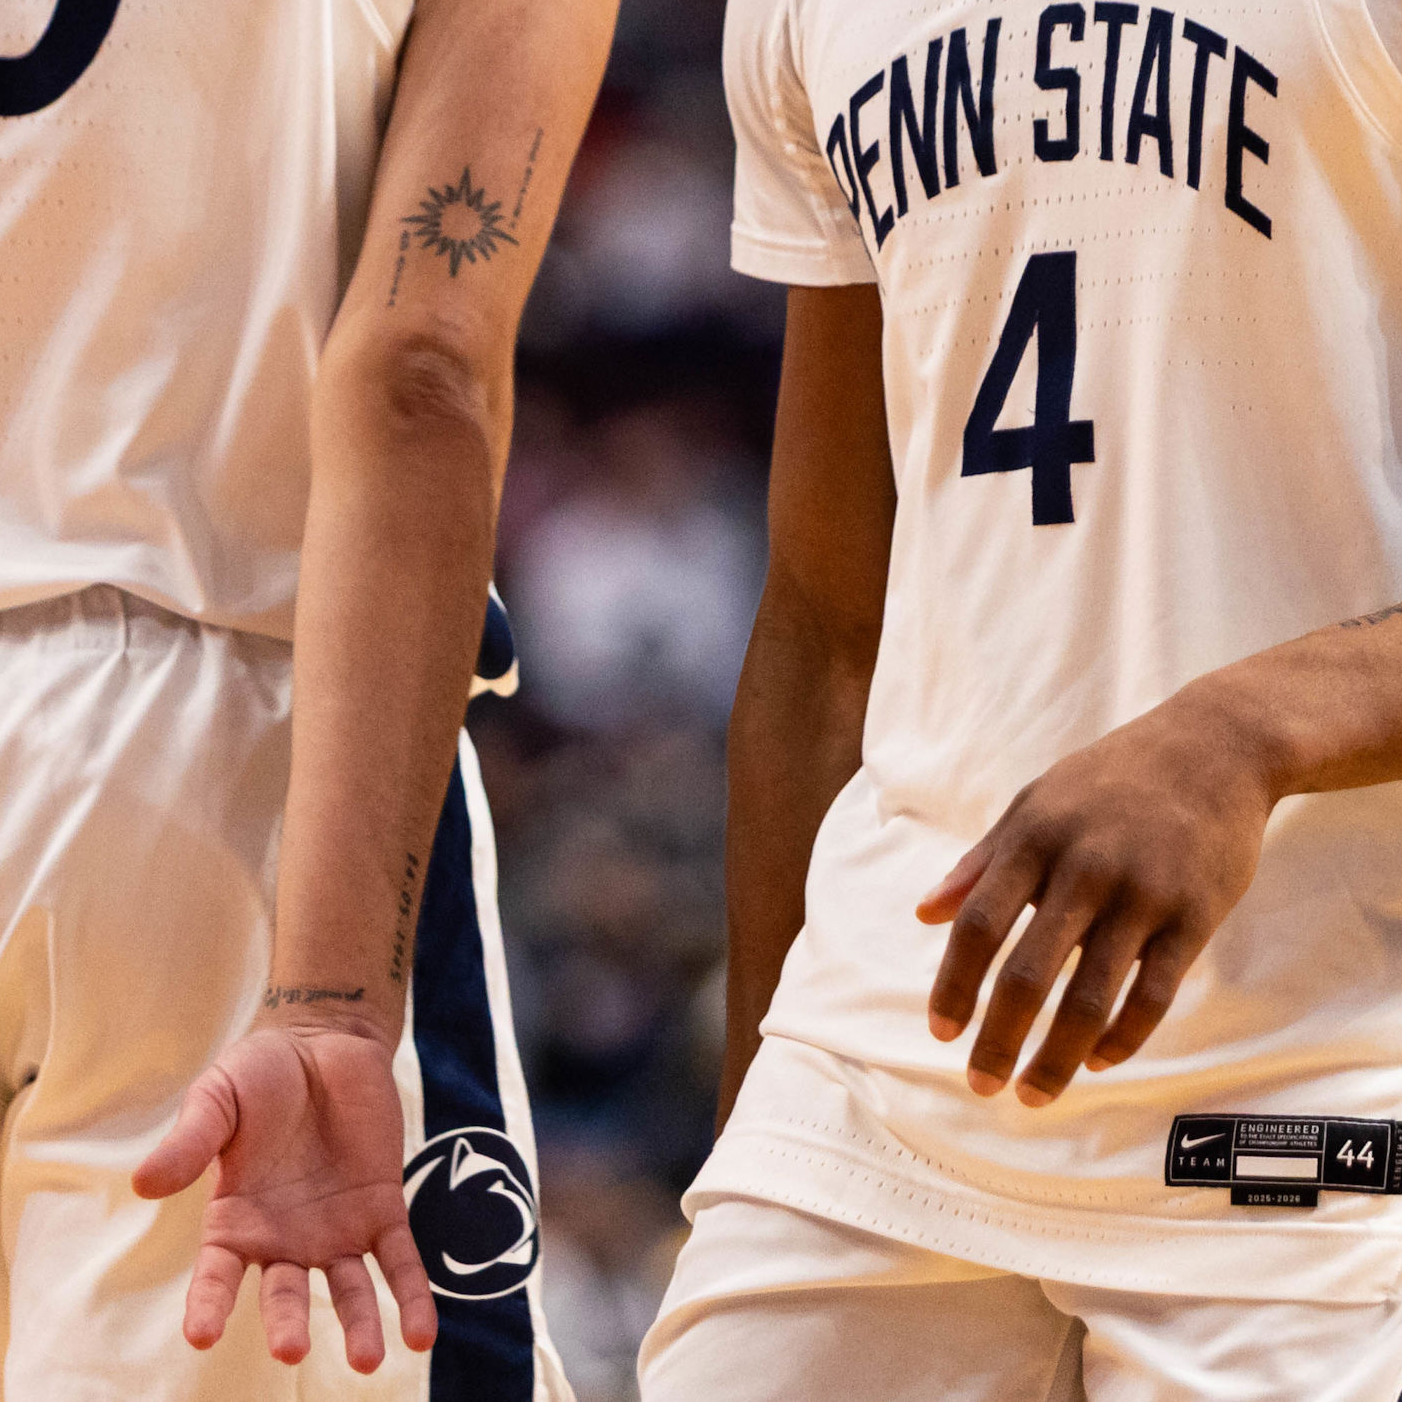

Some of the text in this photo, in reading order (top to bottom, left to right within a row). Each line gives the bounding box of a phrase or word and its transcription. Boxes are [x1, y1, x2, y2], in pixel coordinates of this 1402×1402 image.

[826, 16, 1002, 253] PENN
[1033, 0, 1279, 240] STATE
[960, 250, 1095, 526] 4
[1240, 1123, 1320, 1134] ENGINEERED
[1178, 1156, 1225, 1167] TEAM
[1336, 1139, 1375, 1169] 44
